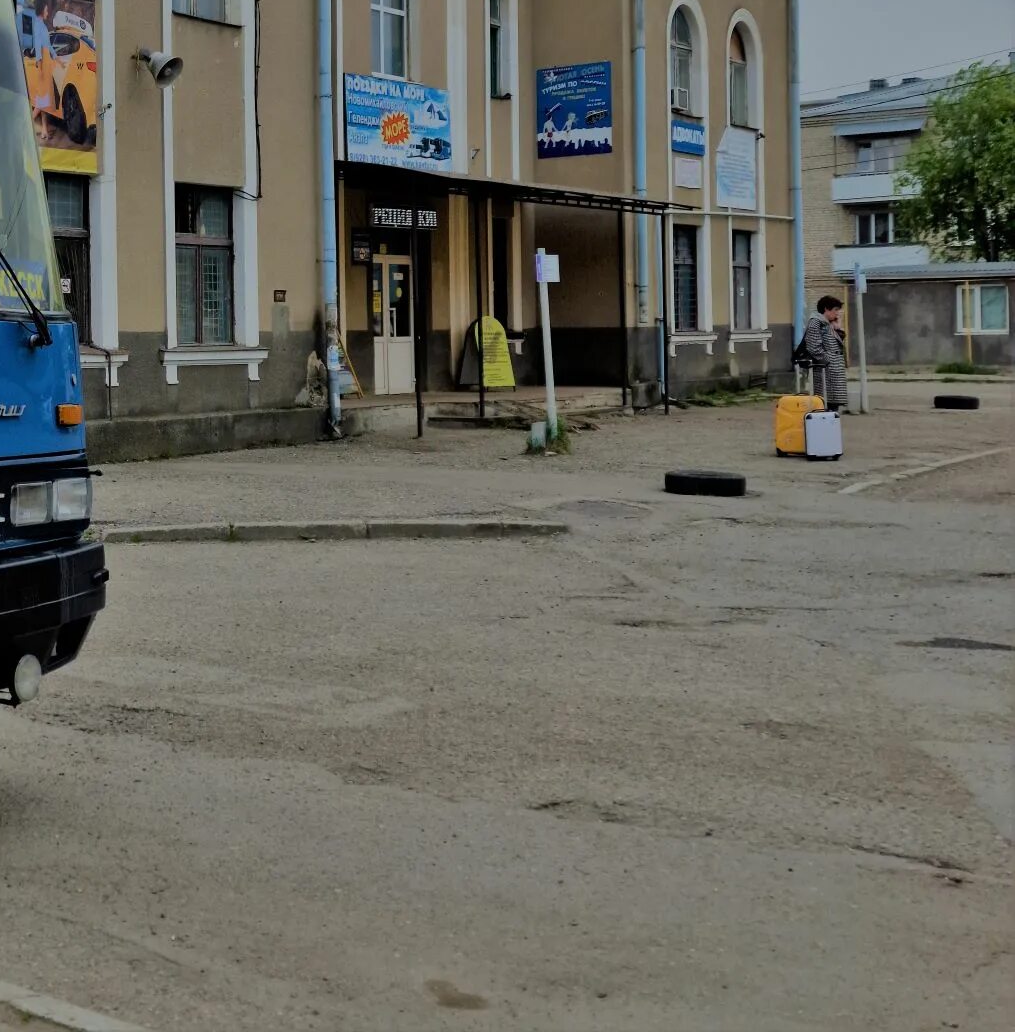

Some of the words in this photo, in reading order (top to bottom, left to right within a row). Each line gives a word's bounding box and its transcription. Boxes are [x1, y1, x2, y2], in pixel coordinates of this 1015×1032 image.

[346, 76, 388, 96] ПОЕЗДКИ
[389, 83, 402, 97] НА
[403, 86, 425, 102] МОРЕ
[541, 83, 567, 95] ТУРИЗМ
[348, 111, 381, 126] Геленджи
[384, 119, 407, 140] МОРЕ
